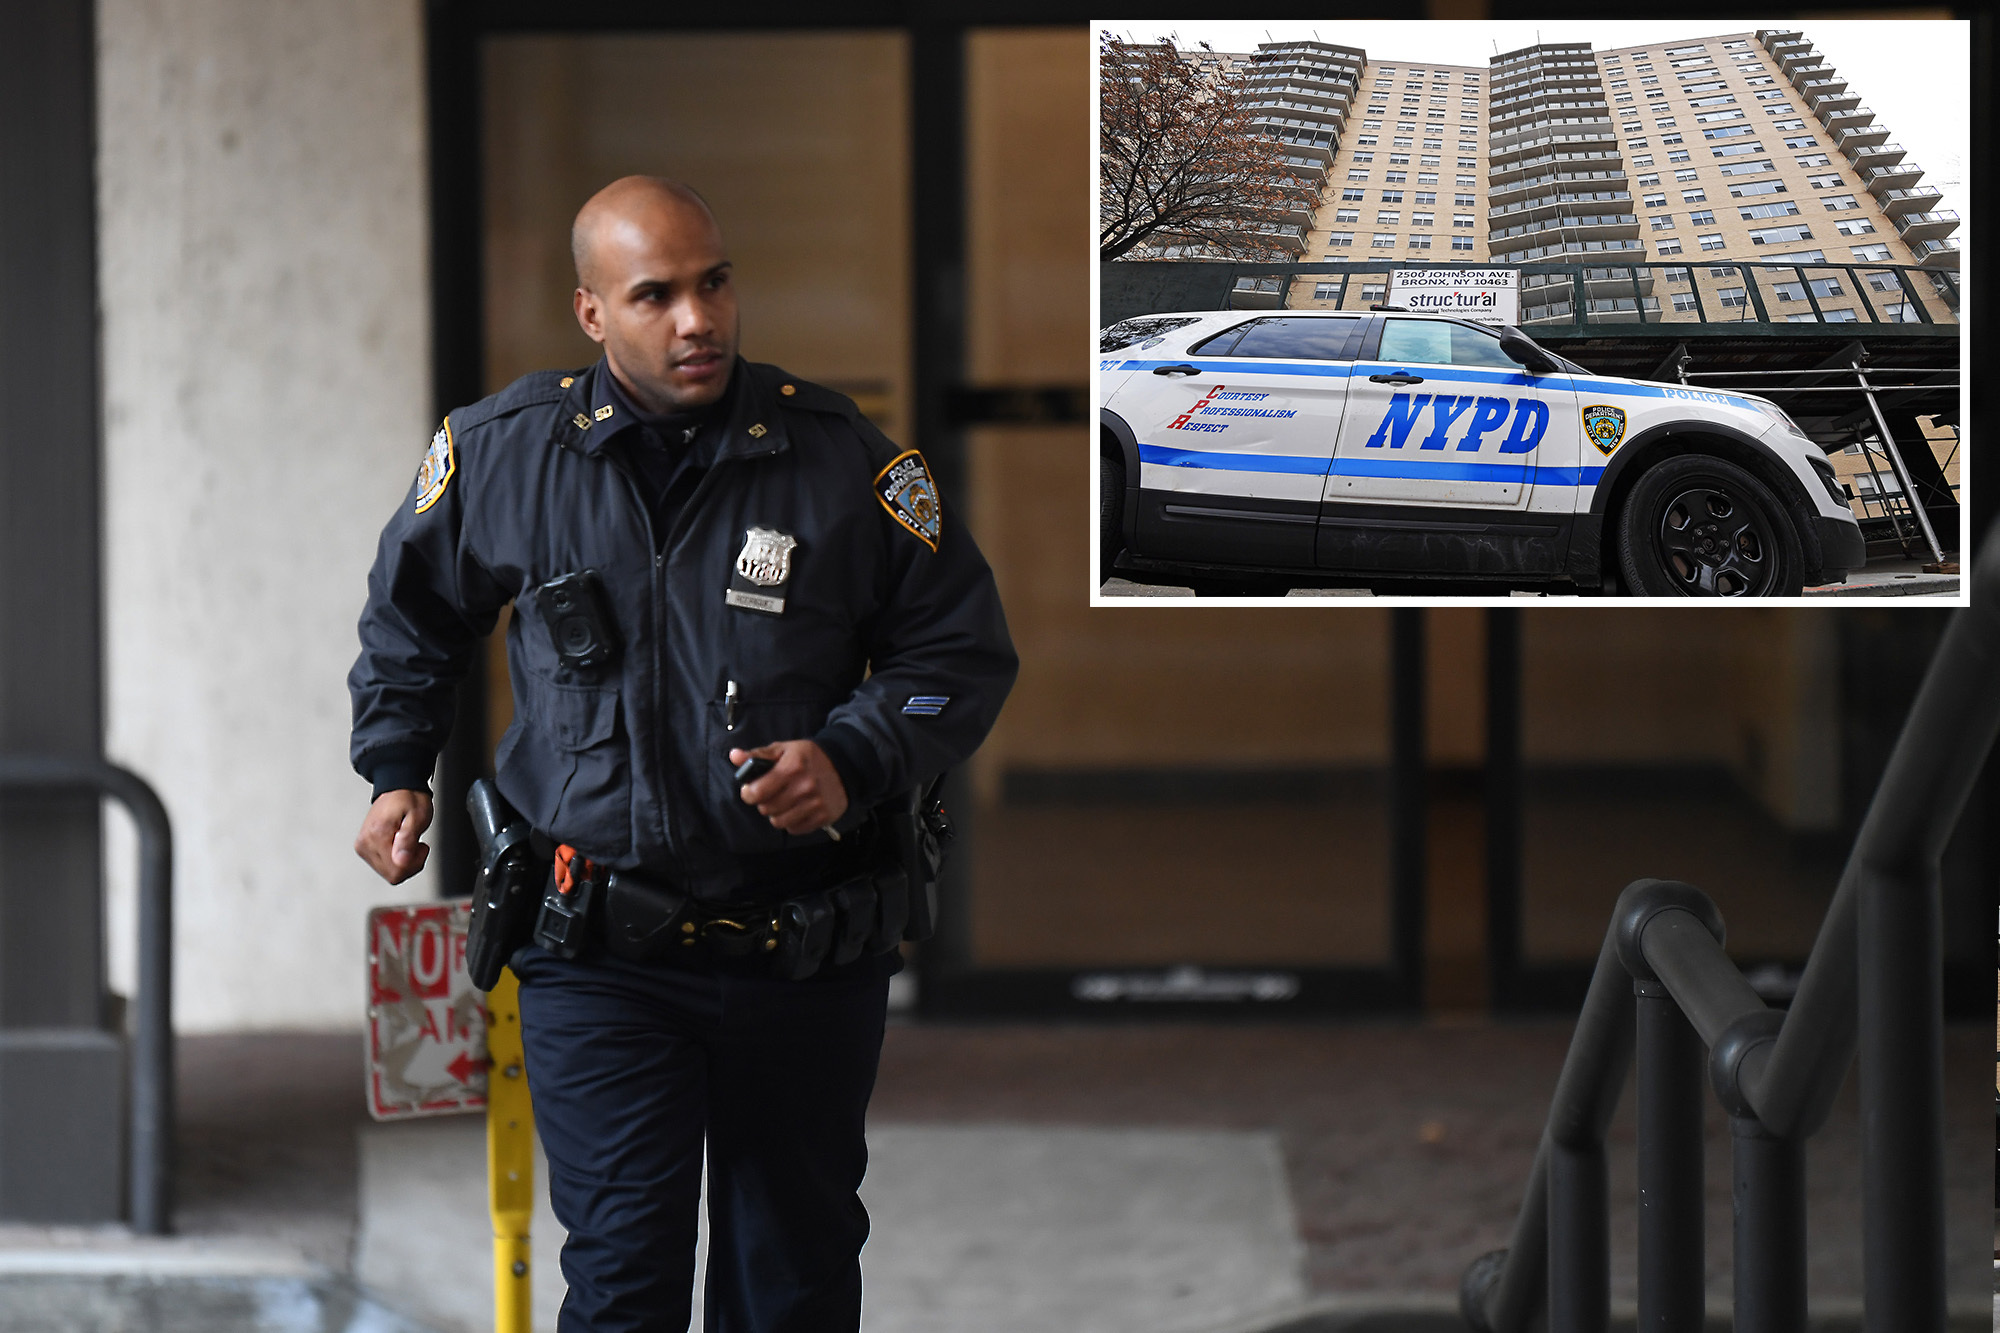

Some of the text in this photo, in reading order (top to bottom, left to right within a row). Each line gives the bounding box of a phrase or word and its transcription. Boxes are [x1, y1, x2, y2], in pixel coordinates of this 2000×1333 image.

[1401, 278, 1509, 287] BRONX, NY 10463
[1428, 271, 1485, 279] JOHNSON
[1488, 271, 1515, 279] AVE.
[1206, 384, 1270, 402] COURTESY
[1665, 388, 1728, 405] POLICE
[1187, 400, 1298, 418] PROFESSIONALISM
[1584, 411, 1624, 421] DEPARTMENT
[1592, 406, 1615, 414] POLICE
[1167, 414, 1230, 433] RESPECT
[1365, 393, 1550, 455] NYPD
[1586, 424, 1595, 438] CITY
[1593, 438, 1602, 446] OF
[1609, 436, 1619, 449] NEW
[377, 920, 445, 990] NO
